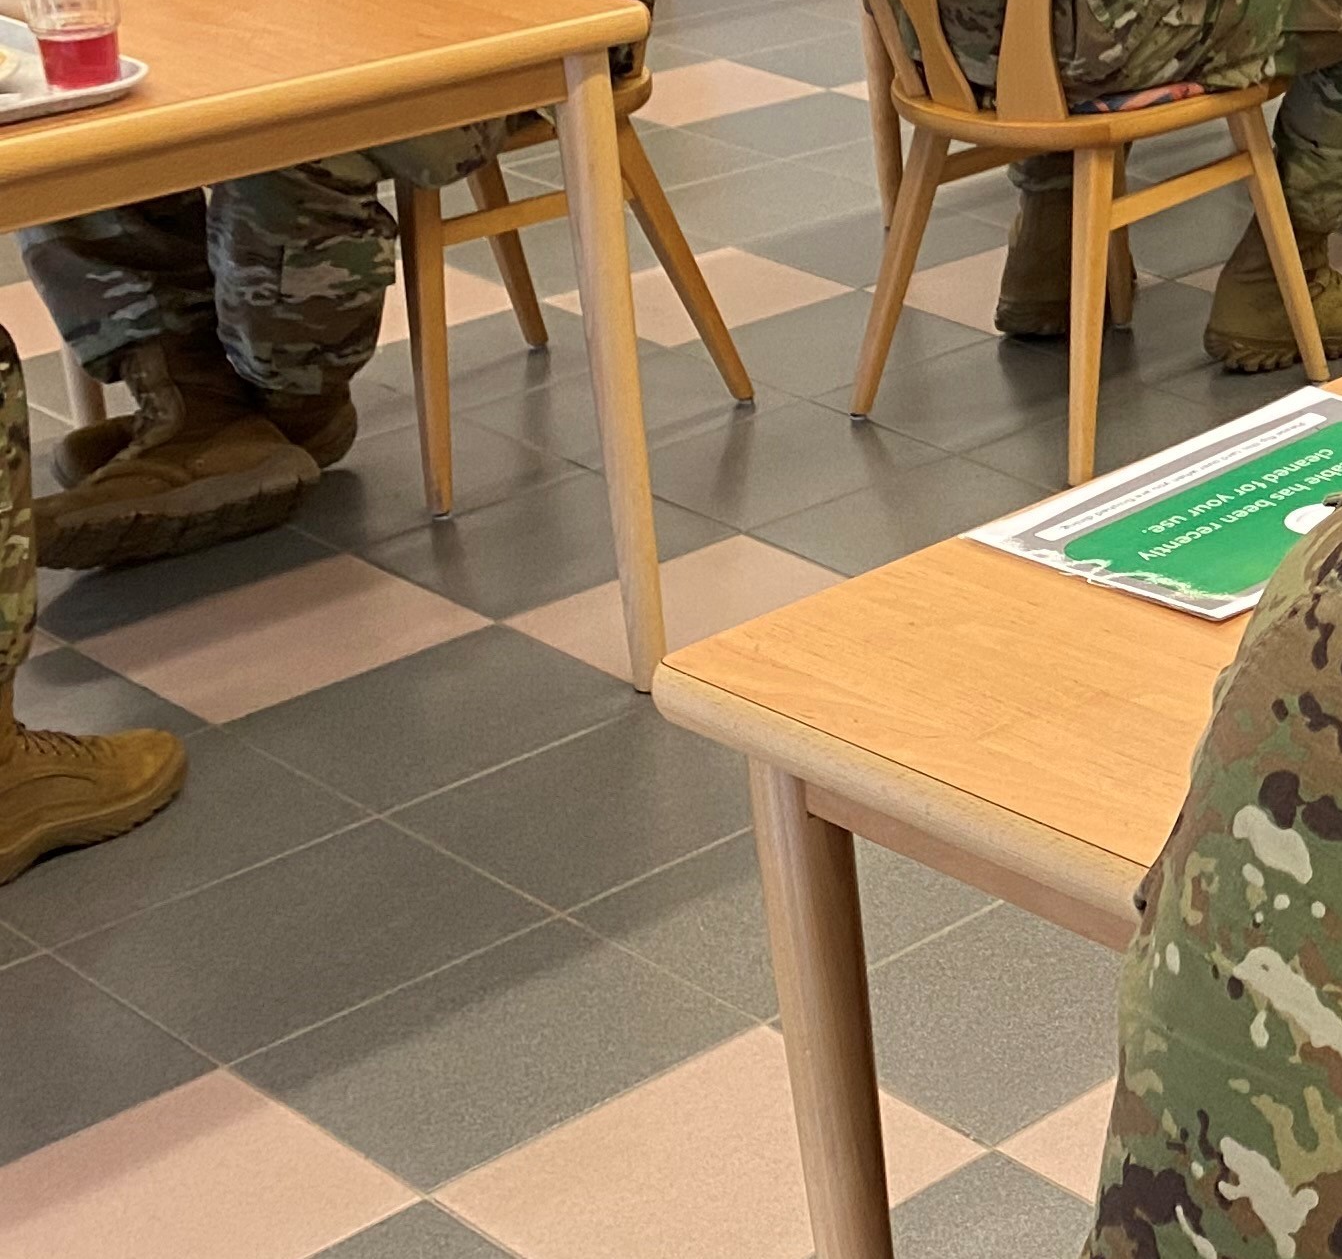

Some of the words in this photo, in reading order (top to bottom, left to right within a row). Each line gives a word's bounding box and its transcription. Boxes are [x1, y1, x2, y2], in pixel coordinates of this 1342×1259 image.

[1261, 448, 1335, 484] cleaned
[1233, 479, 1268, 497] for
[1269, 482, 1311, 501] has
[1187, 492, 1236, 518] your
[1219, 498, 1277, 524] been
[1141, 513, 1188, 534] use.
[1137, 520, 1223, 561] recently
